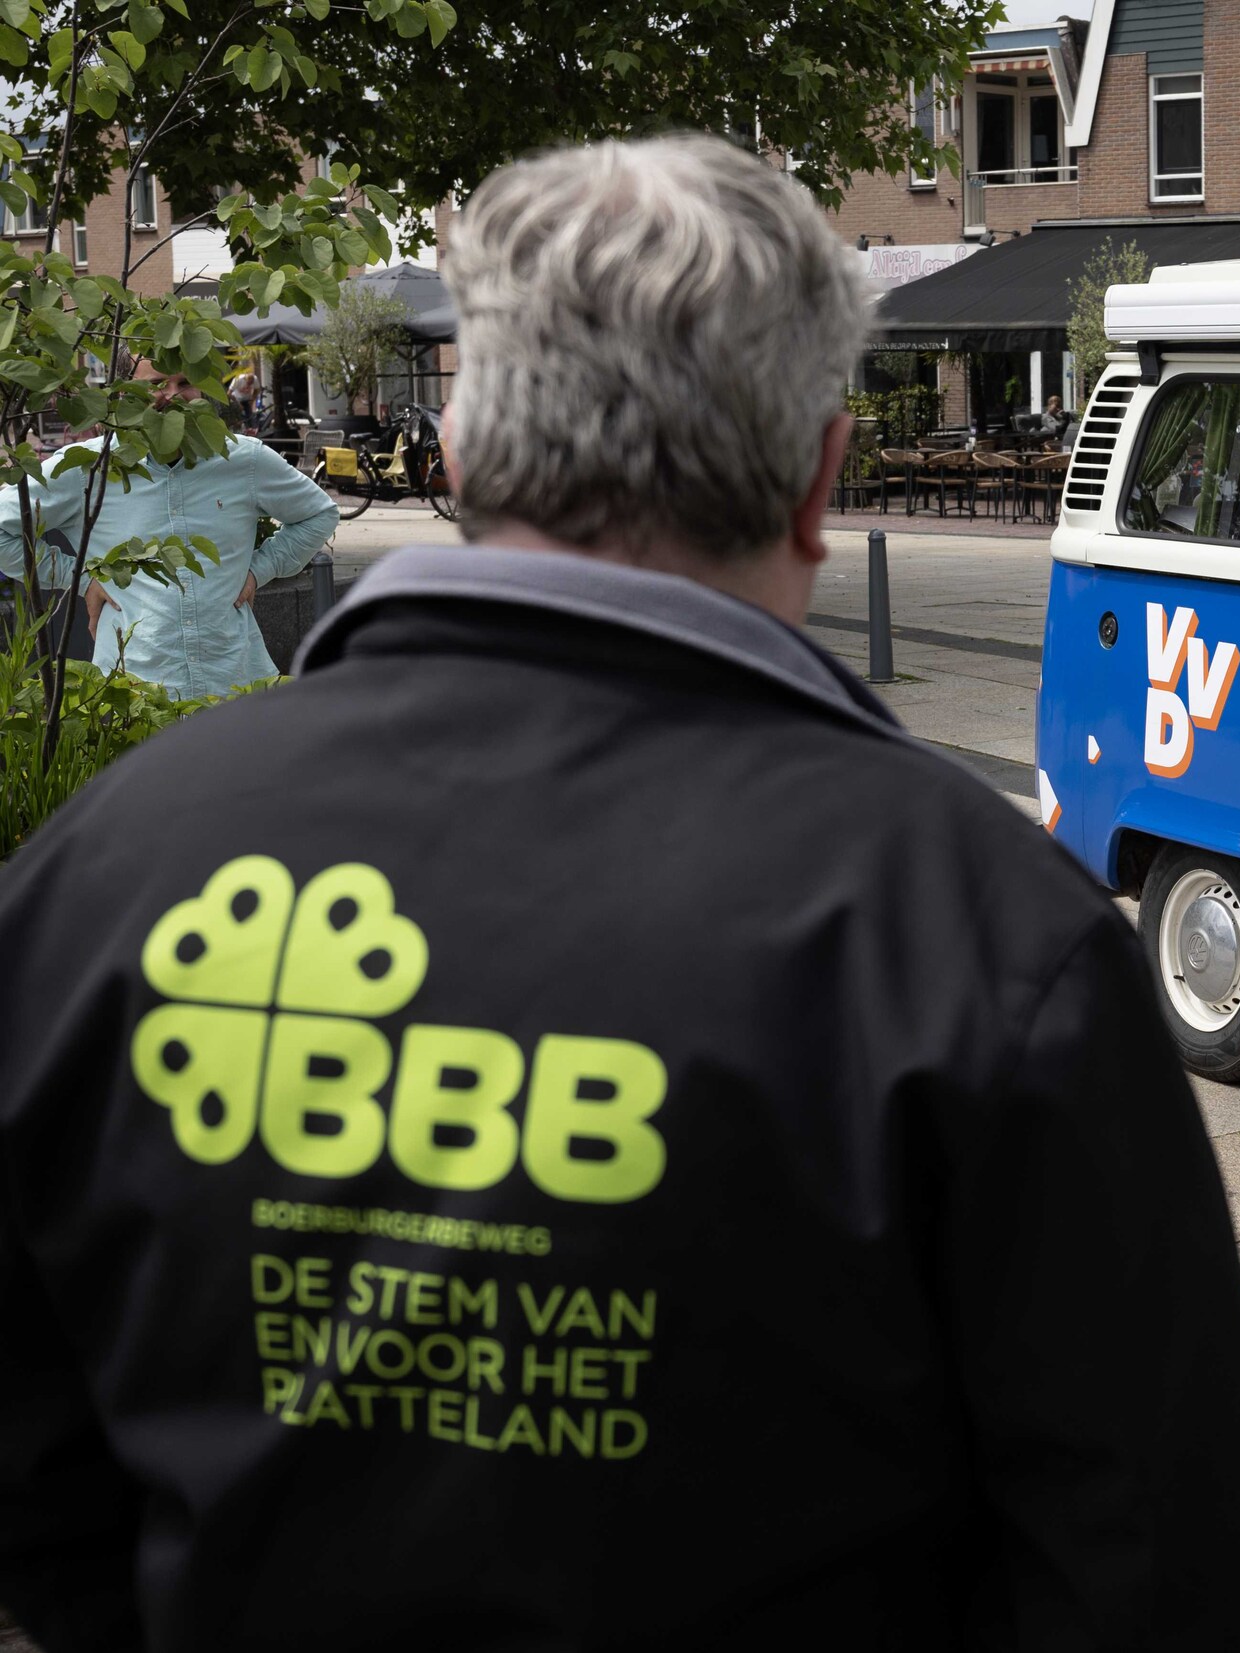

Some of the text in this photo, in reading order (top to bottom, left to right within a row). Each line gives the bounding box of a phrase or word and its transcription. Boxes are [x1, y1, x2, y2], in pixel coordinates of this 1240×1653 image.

[259, 1012, 668, 1204] BBB
[251, 1253, 657, 1341] DE STEM VAN
[336, 1320, 507, 1395] VOOR
[521, 1344, 652, 1400] HET
